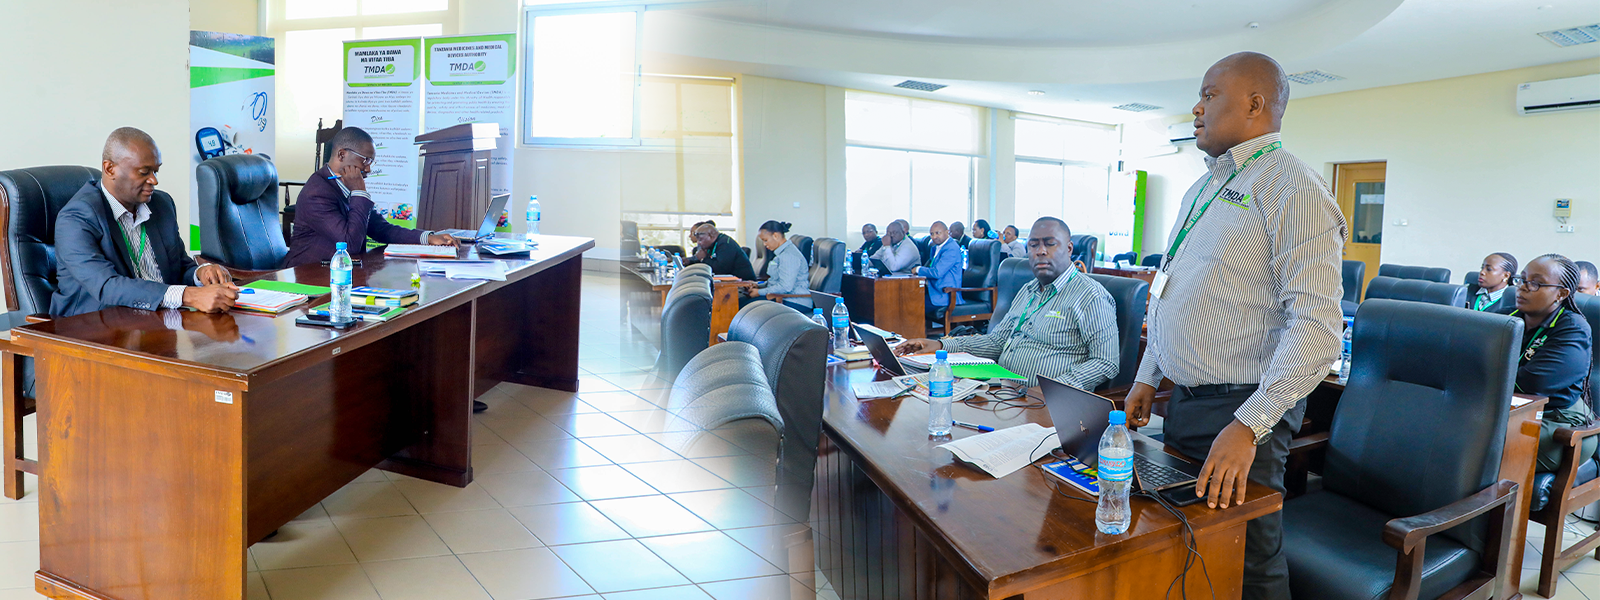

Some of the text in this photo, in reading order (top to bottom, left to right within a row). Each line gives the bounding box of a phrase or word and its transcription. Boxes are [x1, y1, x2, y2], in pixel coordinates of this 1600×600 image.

[364, 65, 386, 74] TMDA
[450, 62, 474, 71] TMDA
[1222, 188, 1244, 202] TMDA
